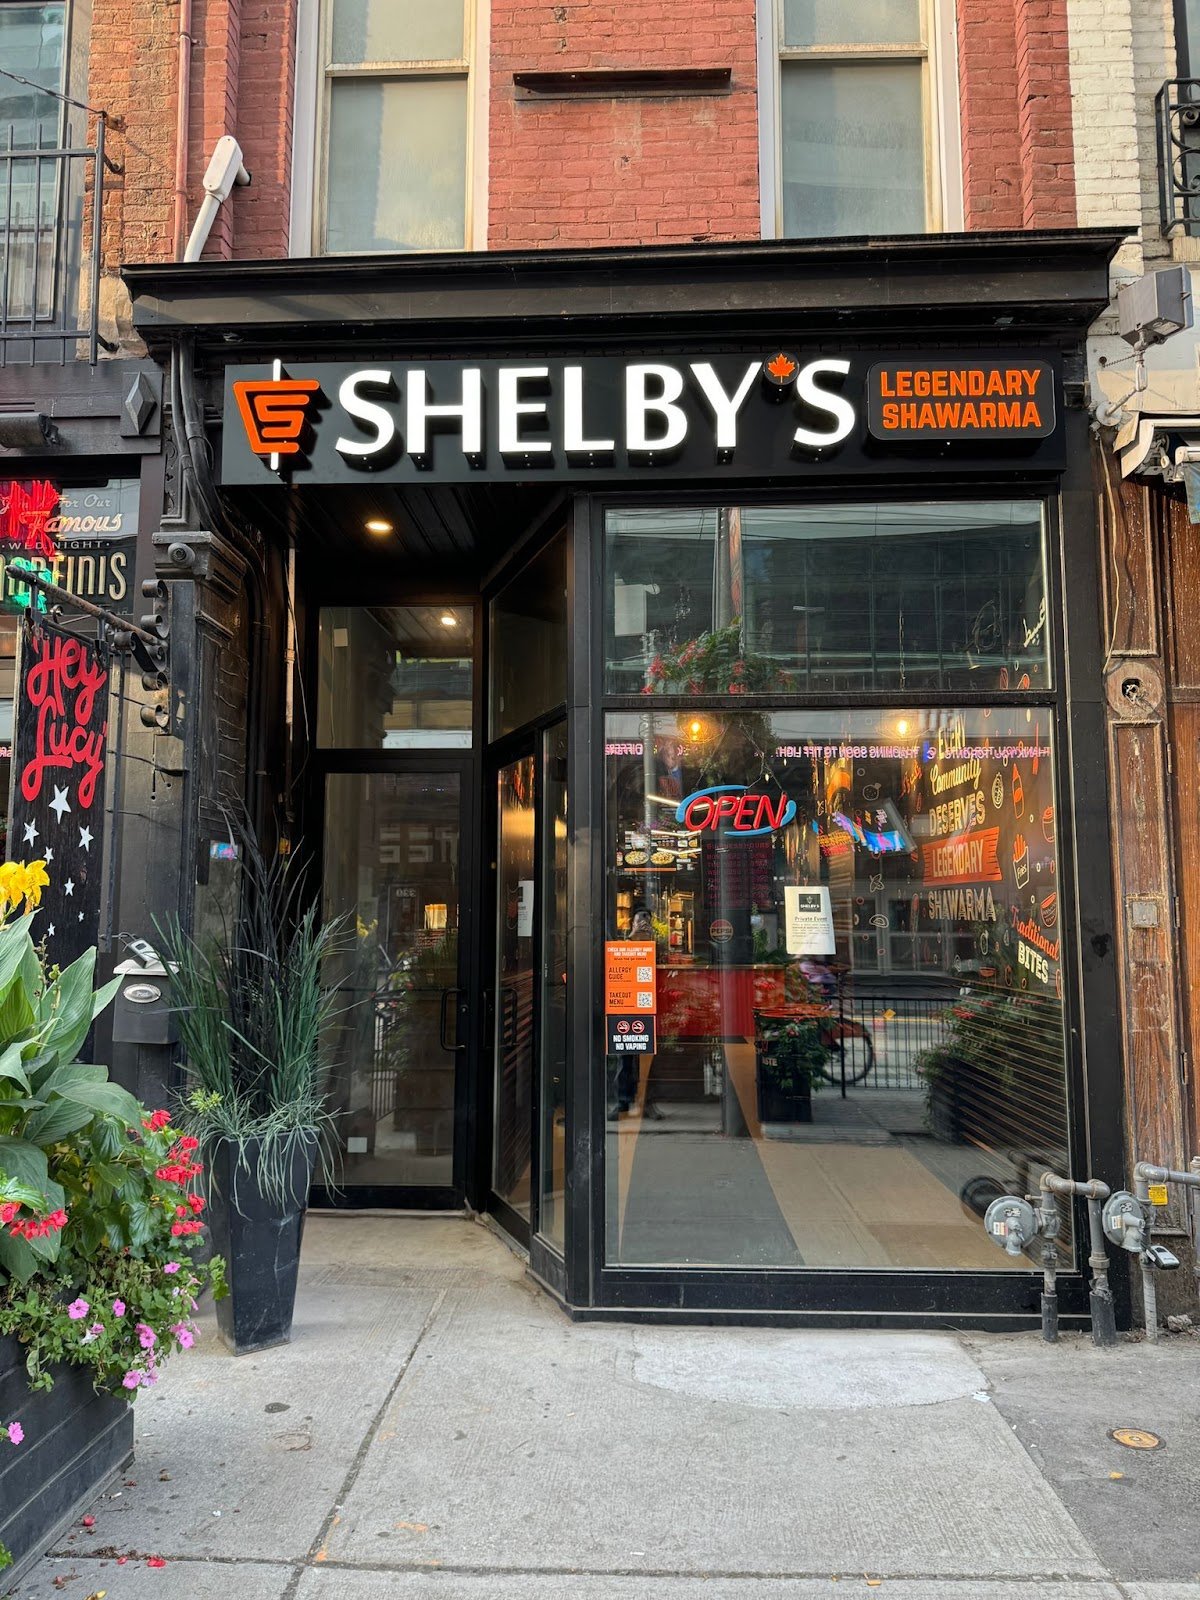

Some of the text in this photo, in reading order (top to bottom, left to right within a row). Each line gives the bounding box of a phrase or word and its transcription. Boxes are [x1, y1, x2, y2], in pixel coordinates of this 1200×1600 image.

[880, 368, 1041, 398] LEGENDARY
[335, 358, 856, 456] SHELBY'S
[882, 401, 1042, 429] SHAWARMA
[84, 494, 111, 508] Our
[53, 541, 103, 549] NIGHT
[930, 758, 982, 796] Community
[685, 791, 787, 832] OPEN
[929, 790, 986, 836] DESERVES
[932, 839, 984, 877] LEGENDARY
[928, 886, 997, 921] SHAWARMA
[1011, 904, 1060, 962] Traditional
[1018, 940, 1049, 984] BITES
[613, 1034, 649, 1042] NO SMOKING
